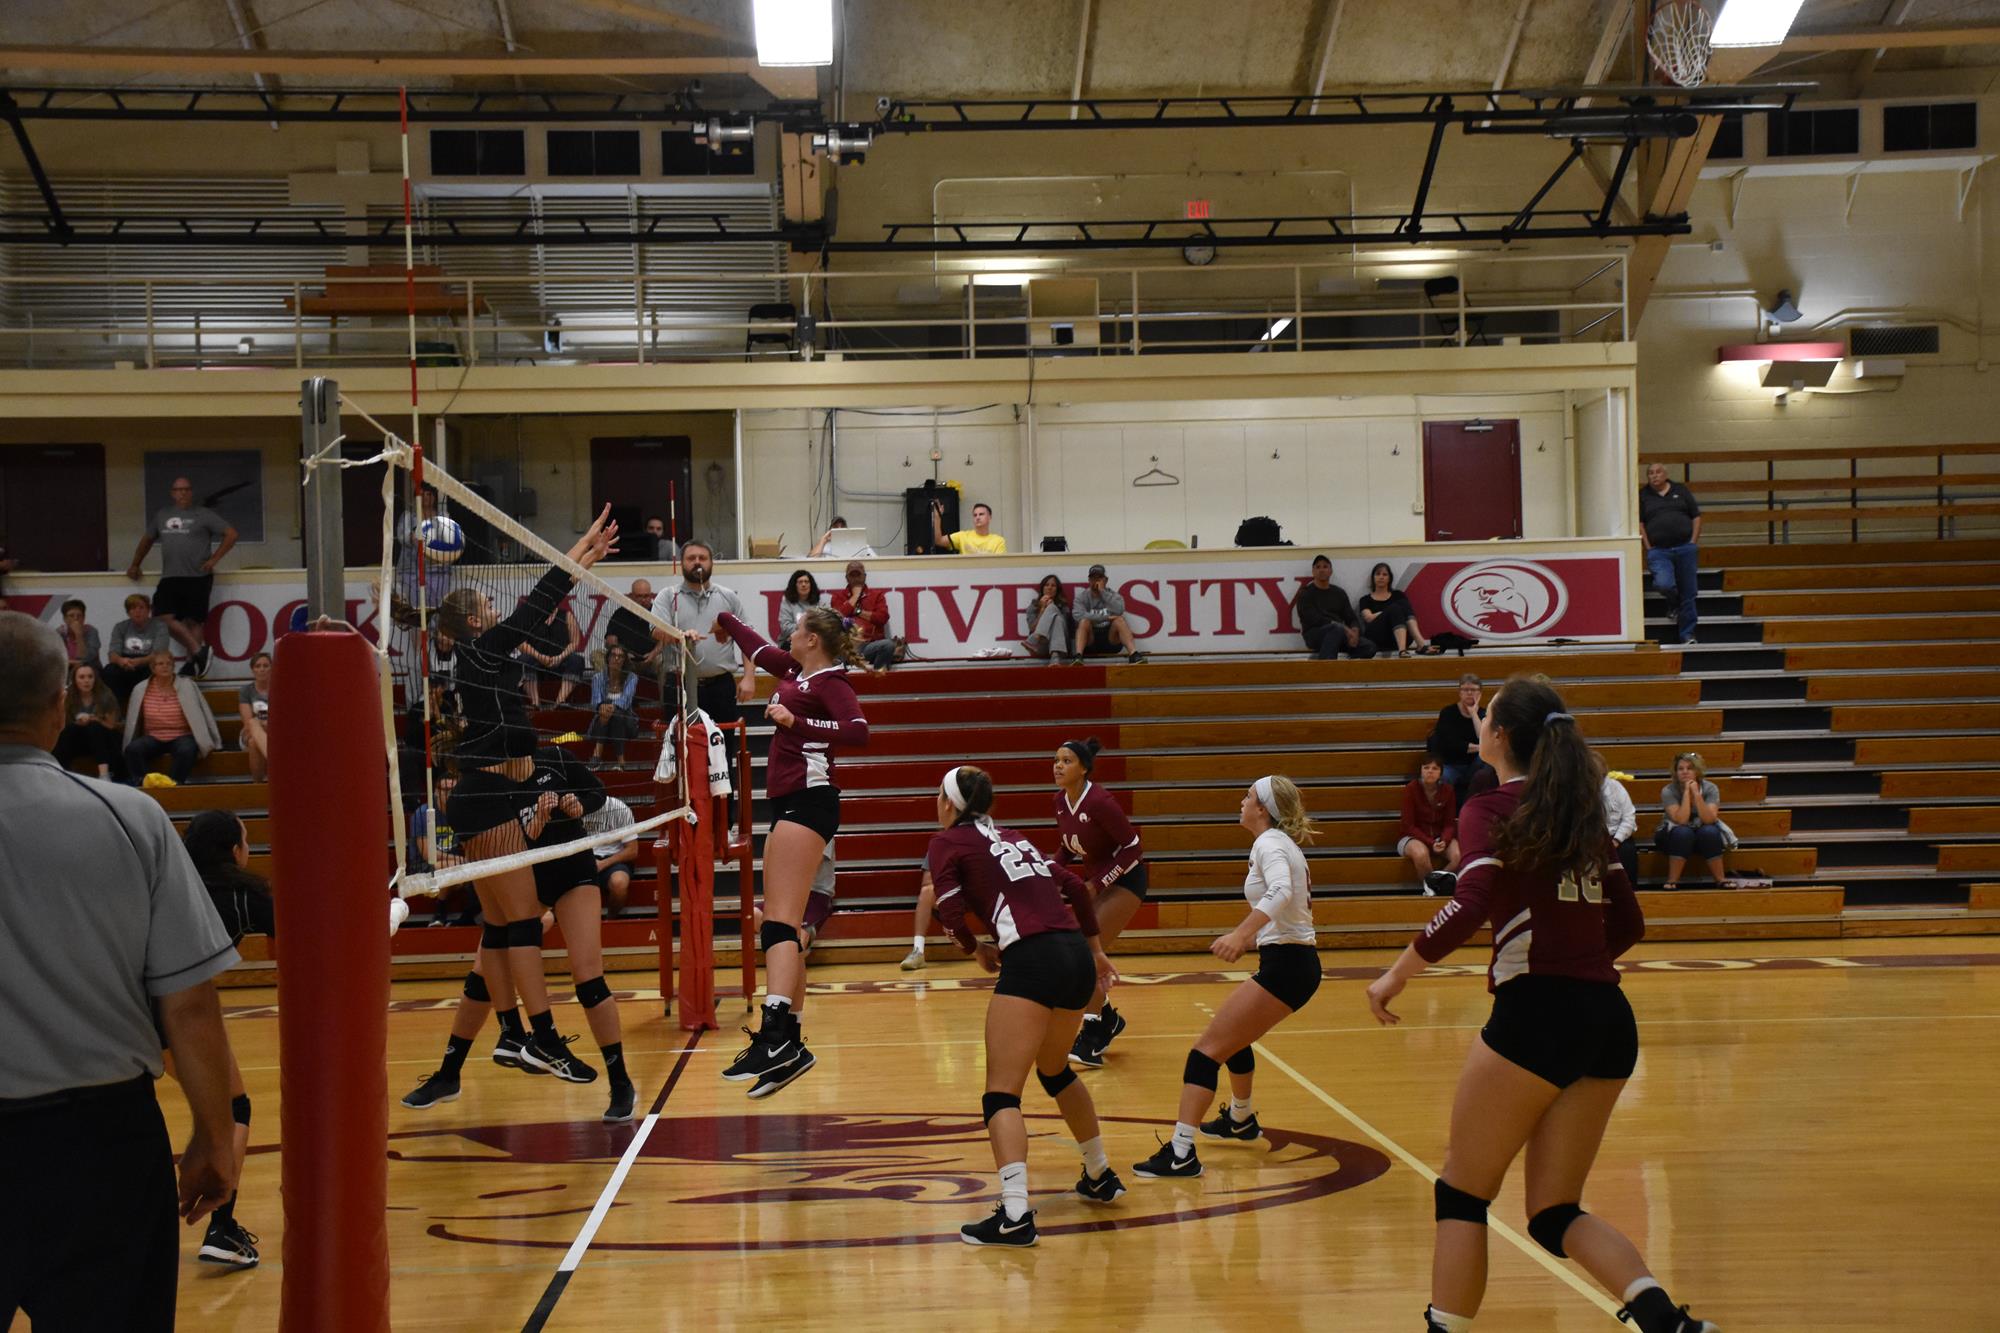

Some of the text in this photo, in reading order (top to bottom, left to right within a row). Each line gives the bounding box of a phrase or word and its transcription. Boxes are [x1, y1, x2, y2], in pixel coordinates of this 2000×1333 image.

[759, 575, 1314, 646] UIVESITY
[990, 840, 1053, 882] 23
[1101, 864, 1124, 887] HAVEN
[1425, 899, 1462, 938] HAVEN
[648, 929, 657, 941] A
[1381, 957, 1880, 976] LOK
